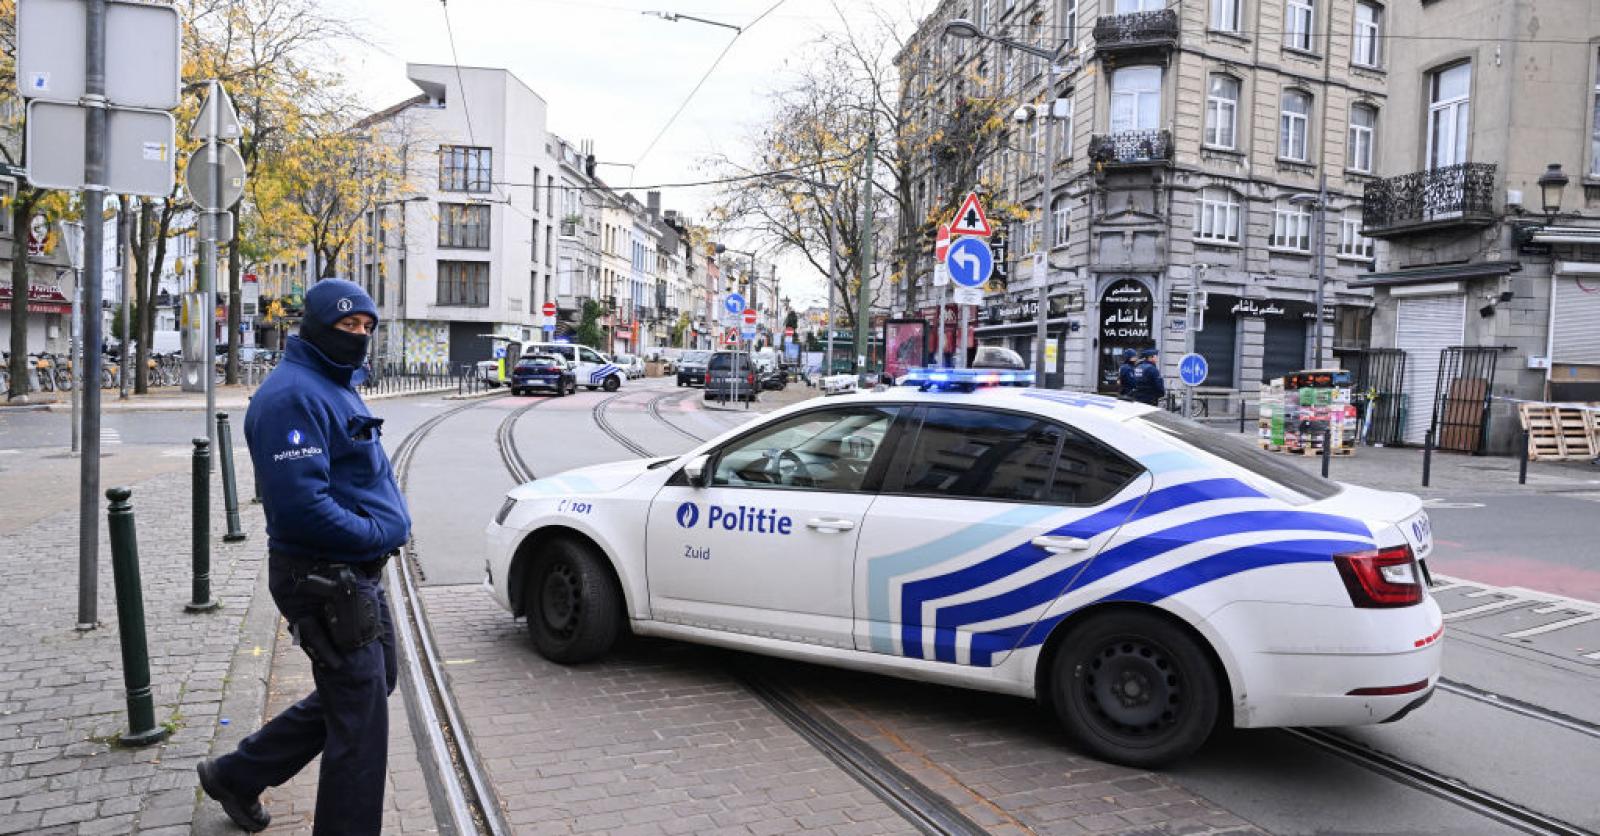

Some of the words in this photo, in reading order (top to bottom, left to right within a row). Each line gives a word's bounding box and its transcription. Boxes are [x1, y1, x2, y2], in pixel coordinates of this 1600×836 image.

[1104, 328, 1117, 337] YA
[1118, 328, 1149, 337] CHAM
[274, 449, 301, 462] Politie
[708, 505, 792, 535] Politie
[684, 545, 711, 560] Zuid
